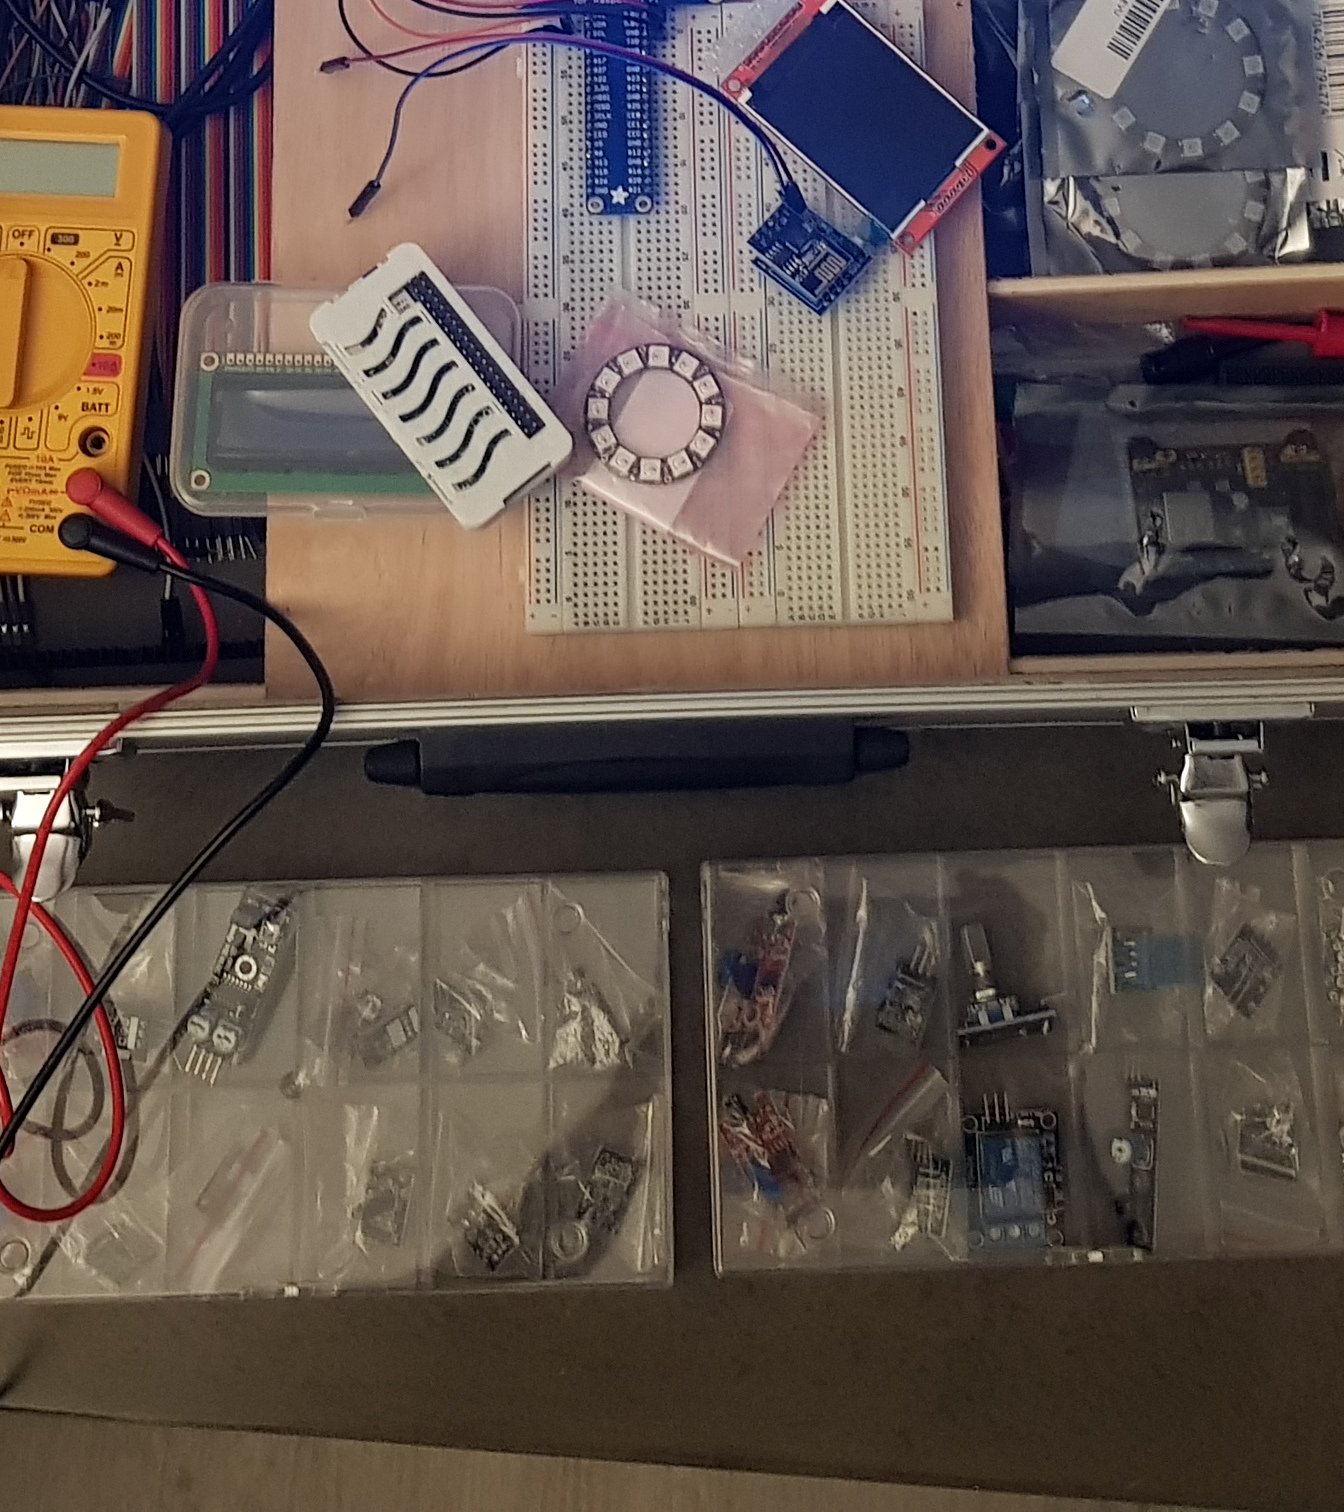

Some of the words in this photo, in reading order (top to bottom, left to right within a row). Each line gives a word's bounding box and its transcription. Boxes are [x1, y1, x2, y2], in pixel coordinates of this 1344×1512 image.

[12, 228, 35, 240] OFF
[81, 402, 111, 413] BATT
[29, 524, 54, 534] COM
